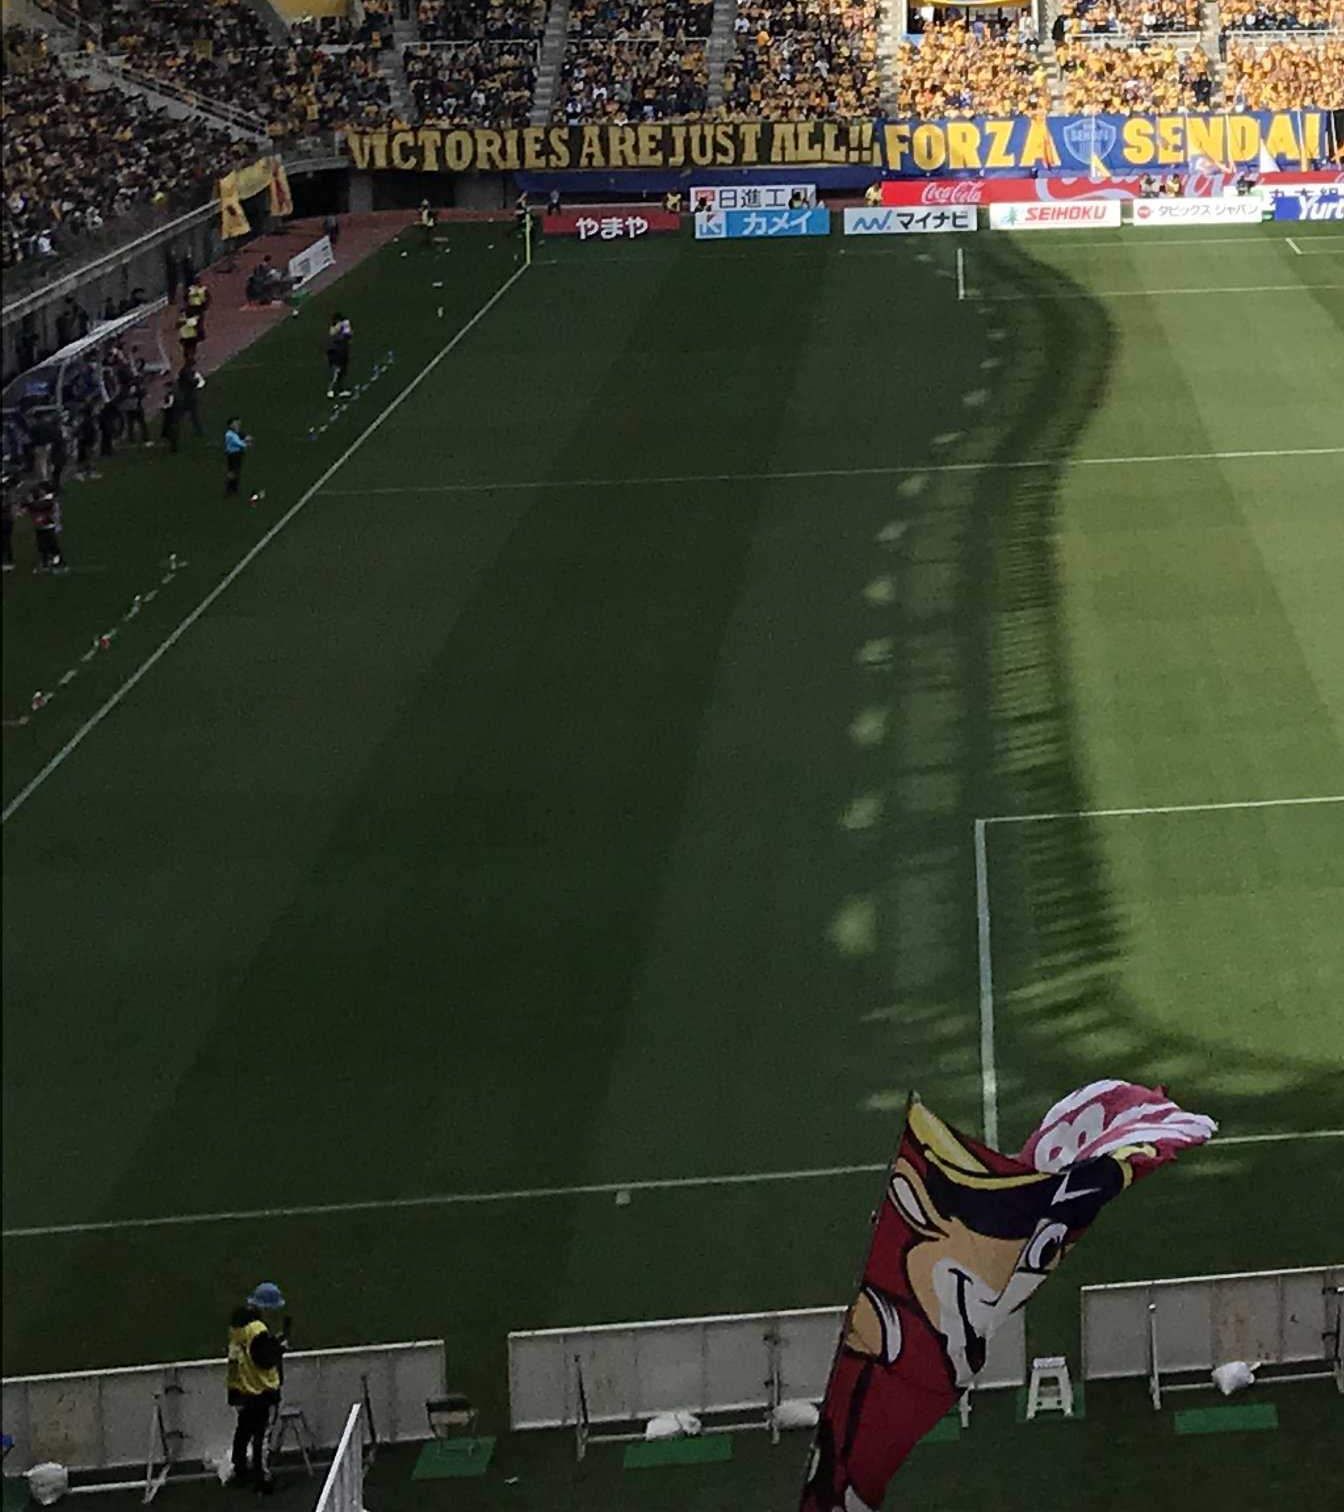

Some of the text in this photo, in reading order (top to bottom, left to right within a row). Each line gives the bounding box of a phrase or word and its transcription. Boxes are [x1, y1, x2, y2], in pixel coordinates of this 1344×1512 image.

[348, 127, 570, 172] VICTORIES
[579, 123, 664, 168] ARE
[668, 122, 763, 167] JUST
[884, 113, 1321, 171] FORZA SENDAI
[742, 210, 813, 235] カメイ
[896, 210, 969, 230] マイナビ
[1025, 205, 1107, 222] SEIHOKU
[576, 216, 649, 239] やまや
